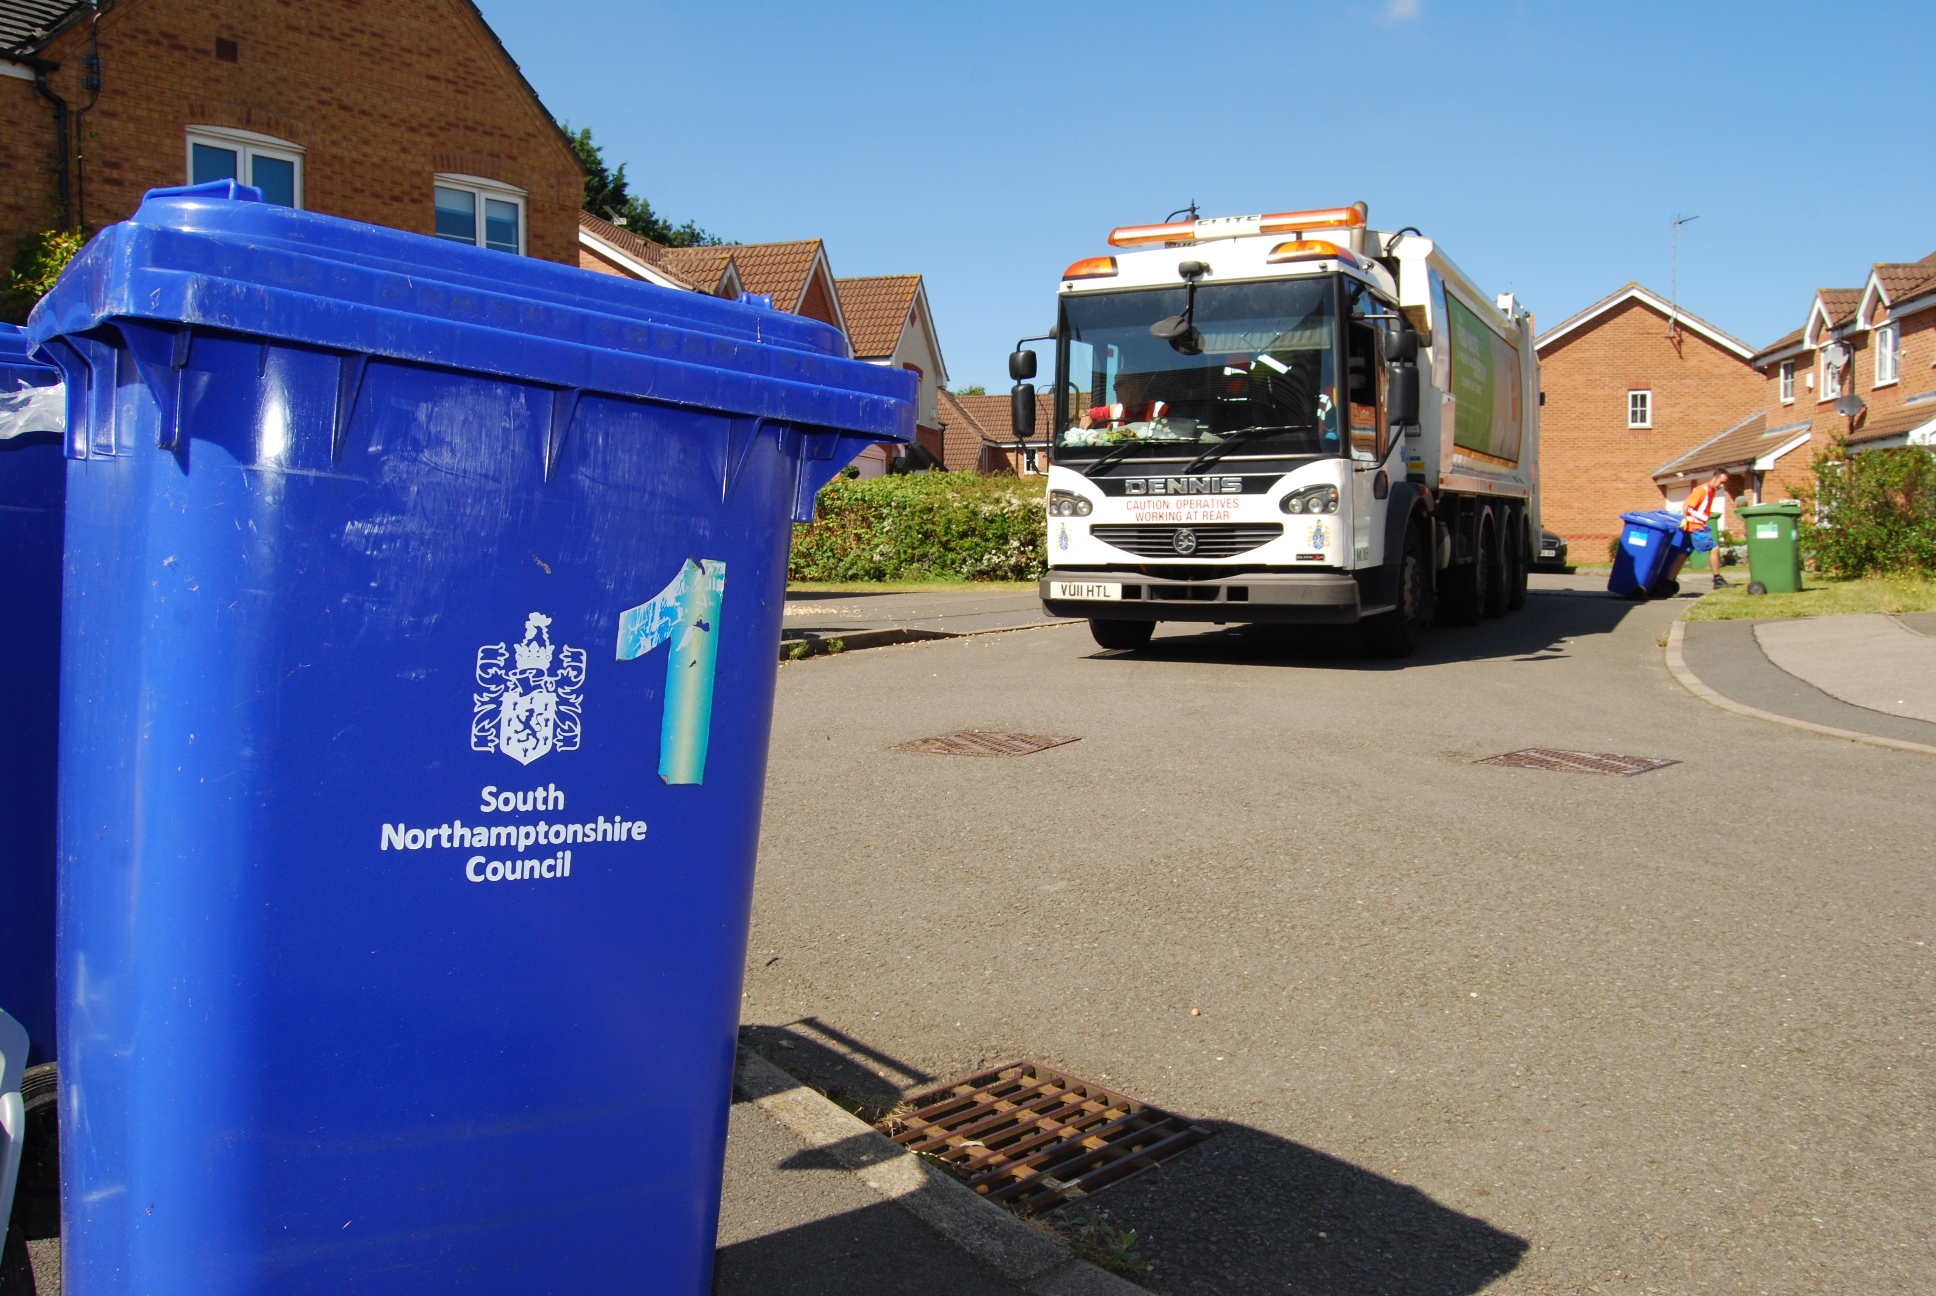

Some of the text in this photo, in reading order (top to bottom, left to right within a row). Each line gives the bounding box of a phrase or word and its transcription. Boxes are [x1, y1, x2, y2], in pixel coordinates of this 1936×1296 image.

[1125, 477, 1243, 495] DENNIS
[1126, 498, 1240, 510] CAUTION: OPERATIVES
[1135, 510, 1230, 522] WORKING AT REAR
[1060, 584, 1111, 598] VU11 HTL
[616, 555, 727, 786] 1
[480, 783, 565, 813] South
[380, 815, 648, 852] Northamptonshire
[465, 850, 571, 883] Council
